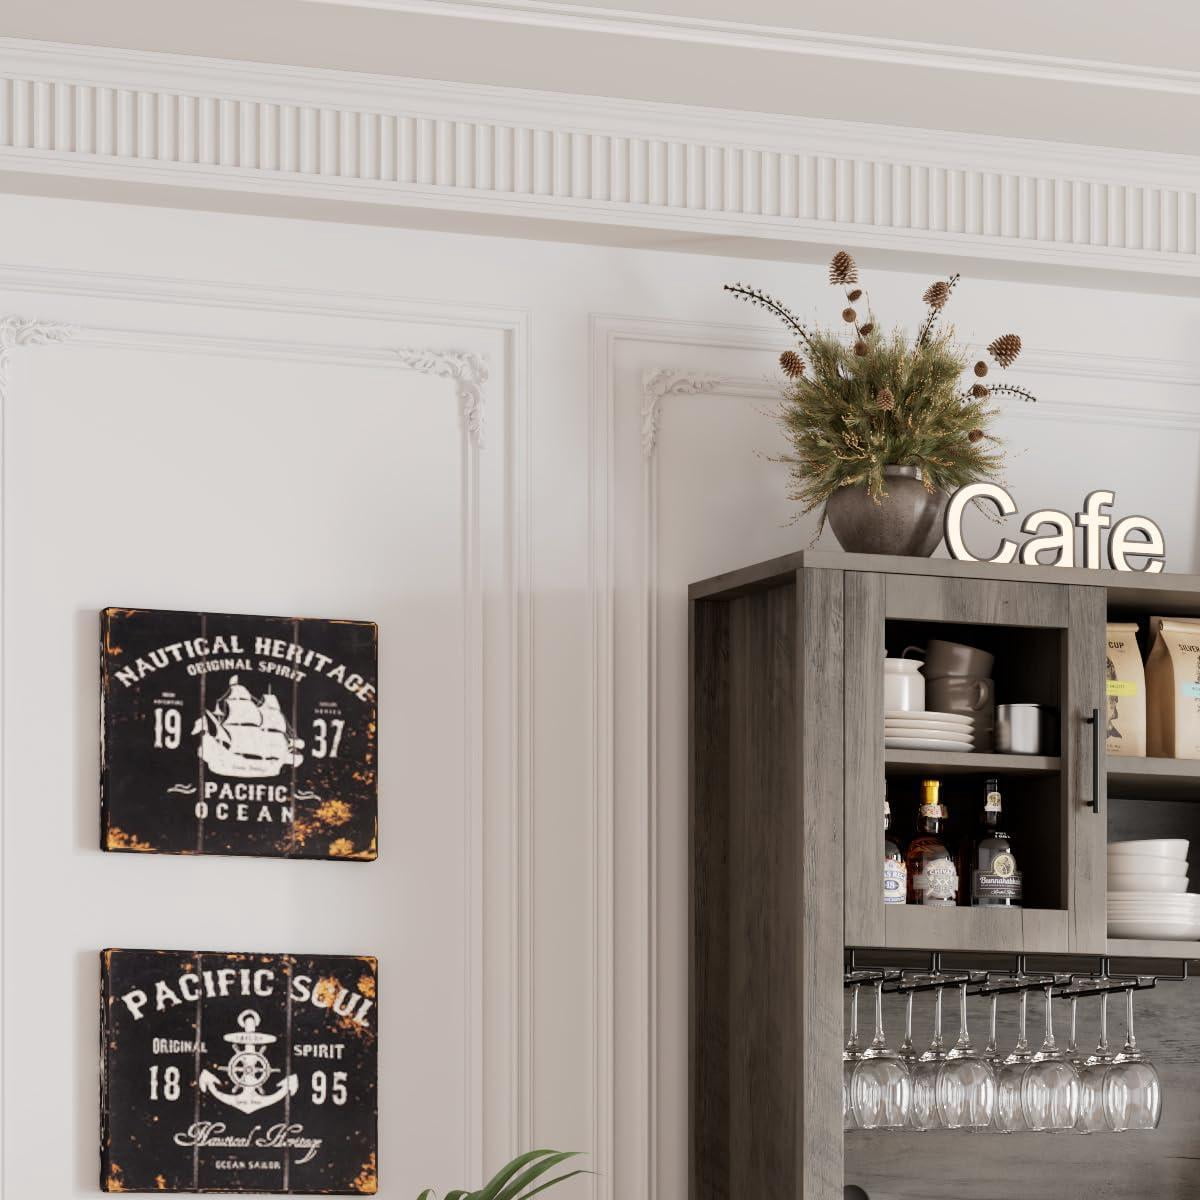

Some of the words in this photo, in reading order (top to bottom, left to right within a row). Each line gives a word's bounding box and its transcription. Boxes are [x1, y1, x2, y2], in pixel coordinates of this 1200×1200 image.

[944, 482, 1166, 574] Cafe
[1108, 641, 1124, 649] CUP
[114, 635, 244, 688] NAUTICAL
[255, 636, 376, 702] HERITAGE
[187, 658, 253, 676] ORIGINAL
[258, 661, 307, 683] SPIRIT
[153, 708, 182, 749] 19
[311, 718, 346, 758] 37
[204, 781, 288, 802] PACIFIC
[194, 802, 295, 823] OCEAN
[121, 968, 275, 1020] PACIFIC
[289, 975, 374, 1027] SOUL
[152, 1037, 208, 1054] ORIGINAL
[294, 1044, 345, 1060] SPIRIT
[149, 1065, 181, 1101] 18
[311, 1070, 348, 1105] 95
[215, 1160, 246, 1170] OCEAN
